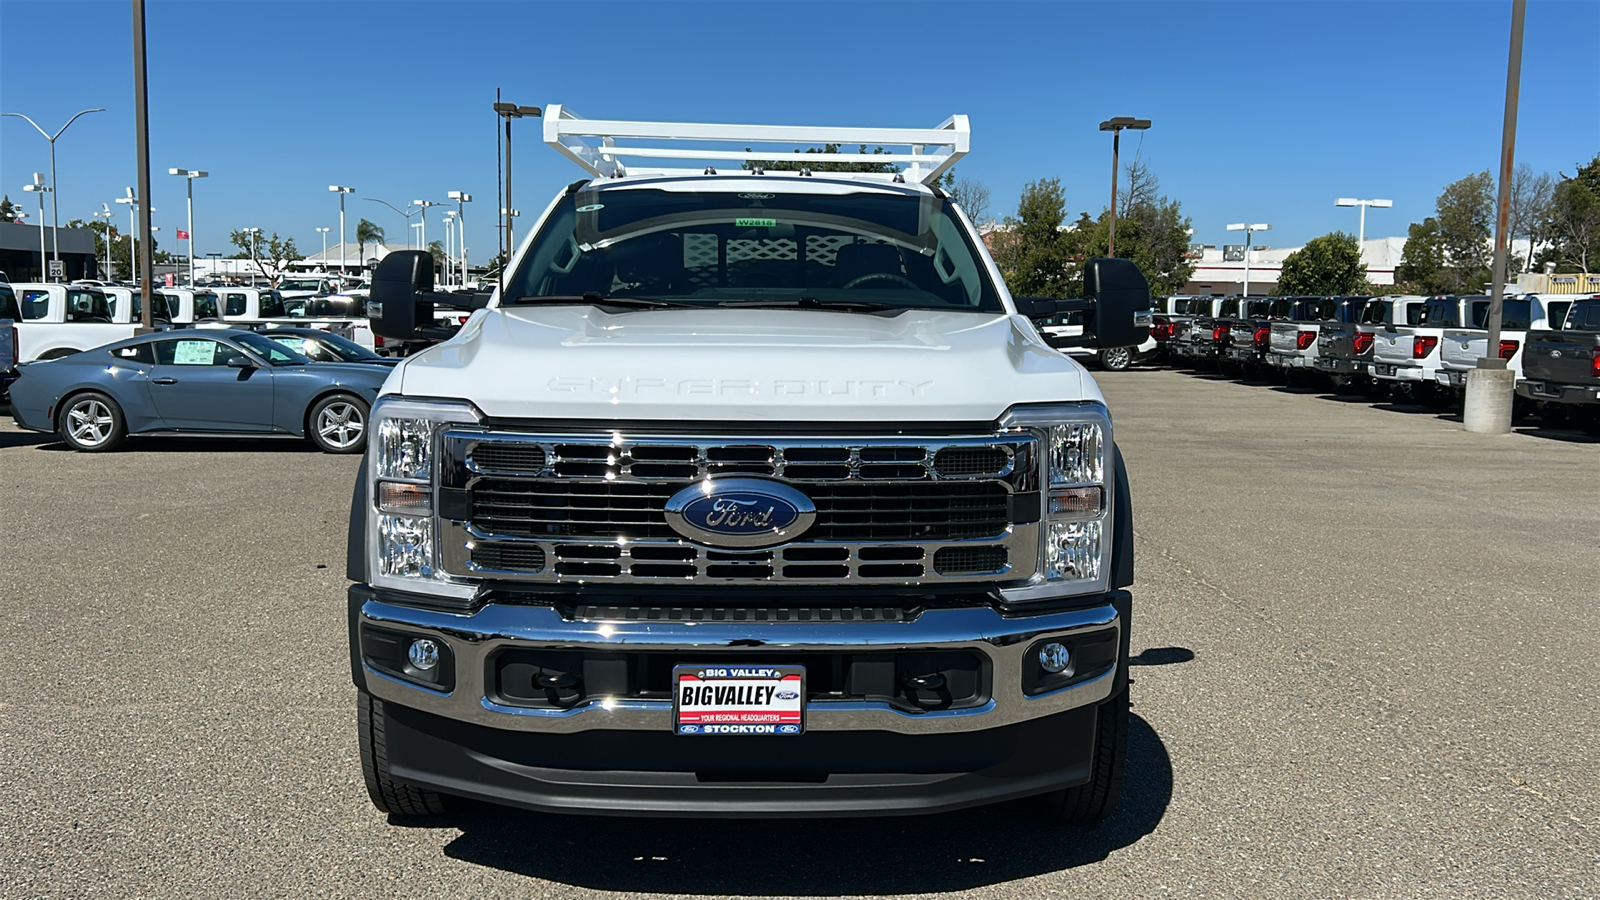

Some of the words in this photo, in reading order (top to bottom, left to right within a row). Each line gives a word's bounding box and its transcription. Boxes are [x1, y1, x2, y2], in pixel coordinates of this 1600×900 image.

[51, 268, 62, 276] 20
[547, 377, 759, 396] SUPER
[774, 379, 935, 397] DUTY
[705, 498, 775, 527] Ford
[705, 669, 727, 677] BIG
[730, 669, 774, 677] VALLEY
[701, 714, 715, 722] YOUR
[715, 714, 740, 722] REGIONAL
[740, 714, 780, 722] HEADQUARTERS
[704, 724, 775, 733] STOCKTON
